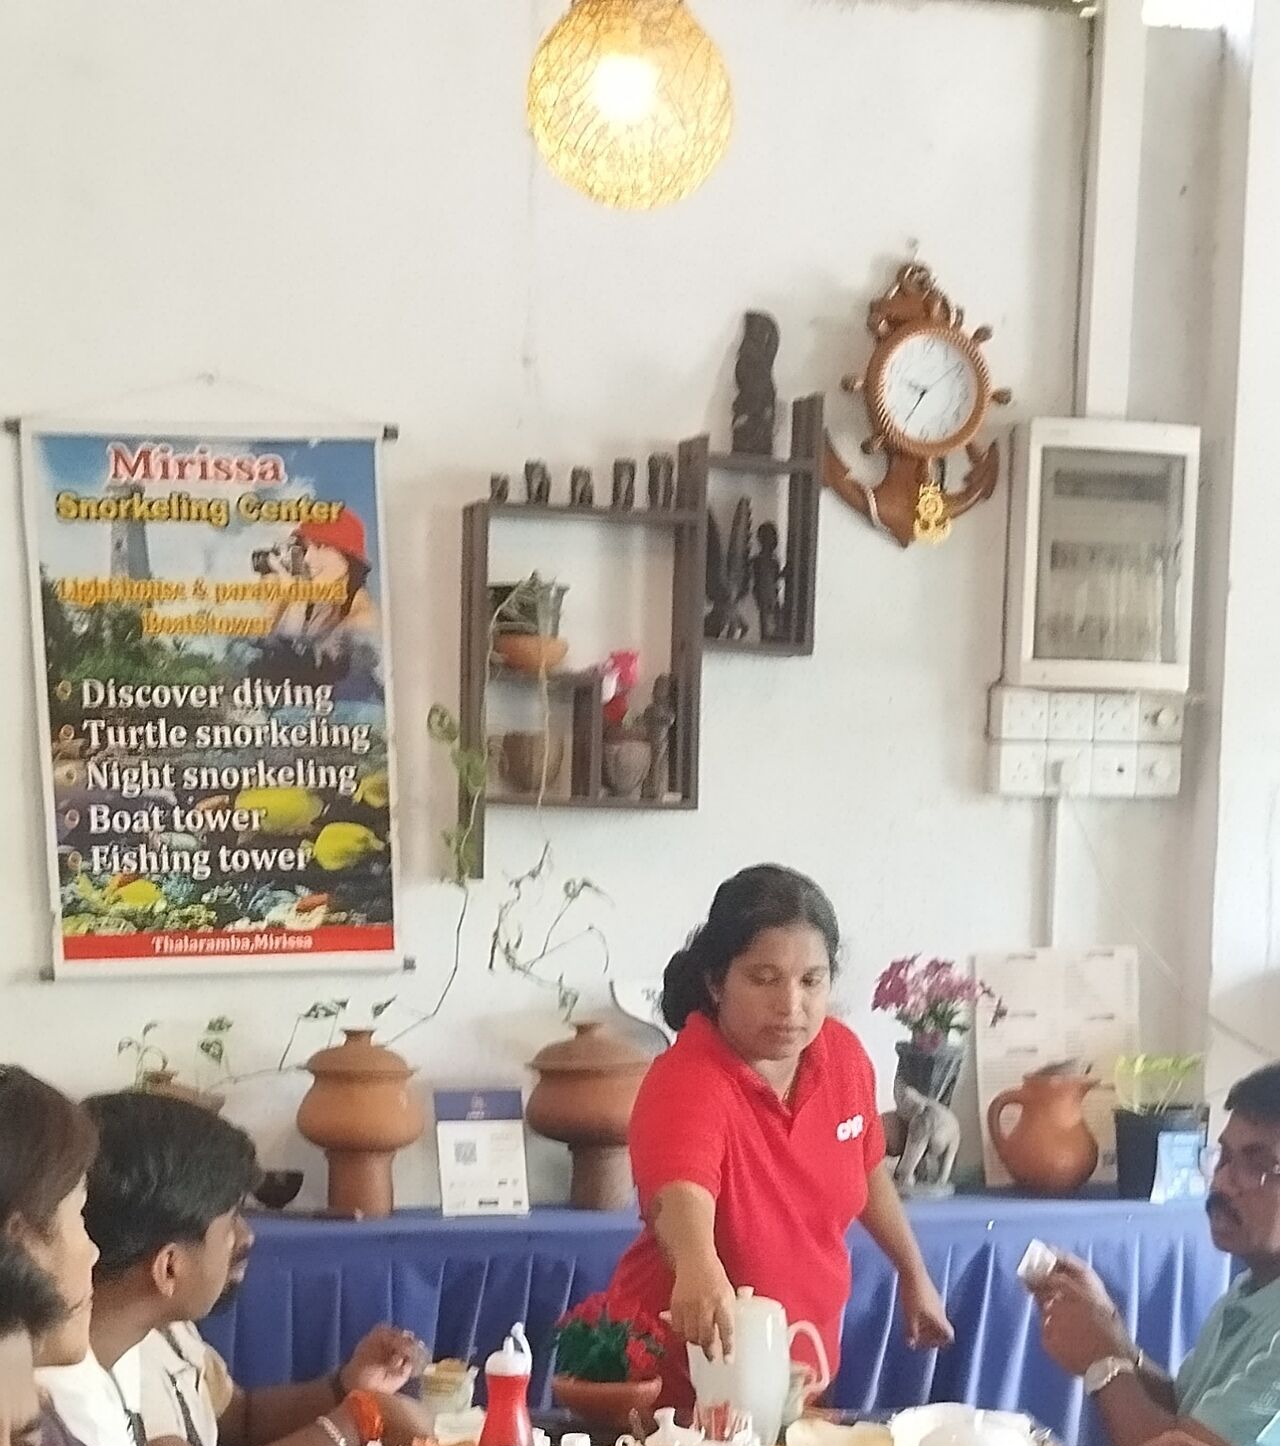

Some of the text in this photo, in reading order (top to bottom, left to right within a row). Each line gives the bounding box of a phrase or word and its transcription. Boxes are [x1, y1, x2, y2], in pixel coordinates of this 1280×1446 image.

[108, 443, 286, 483] Mirissa
[55, 490, 345, 527] Snorkeling Center
[81, 677, 334, 716] Discover diving
[82, 717, 371, 754] Turtle snorkeling
[86, 757, 359, 798] Night snorkeling
[89, 802, 267, 834] Boat tower
[91, 842, 312, 880] Fishing tower
